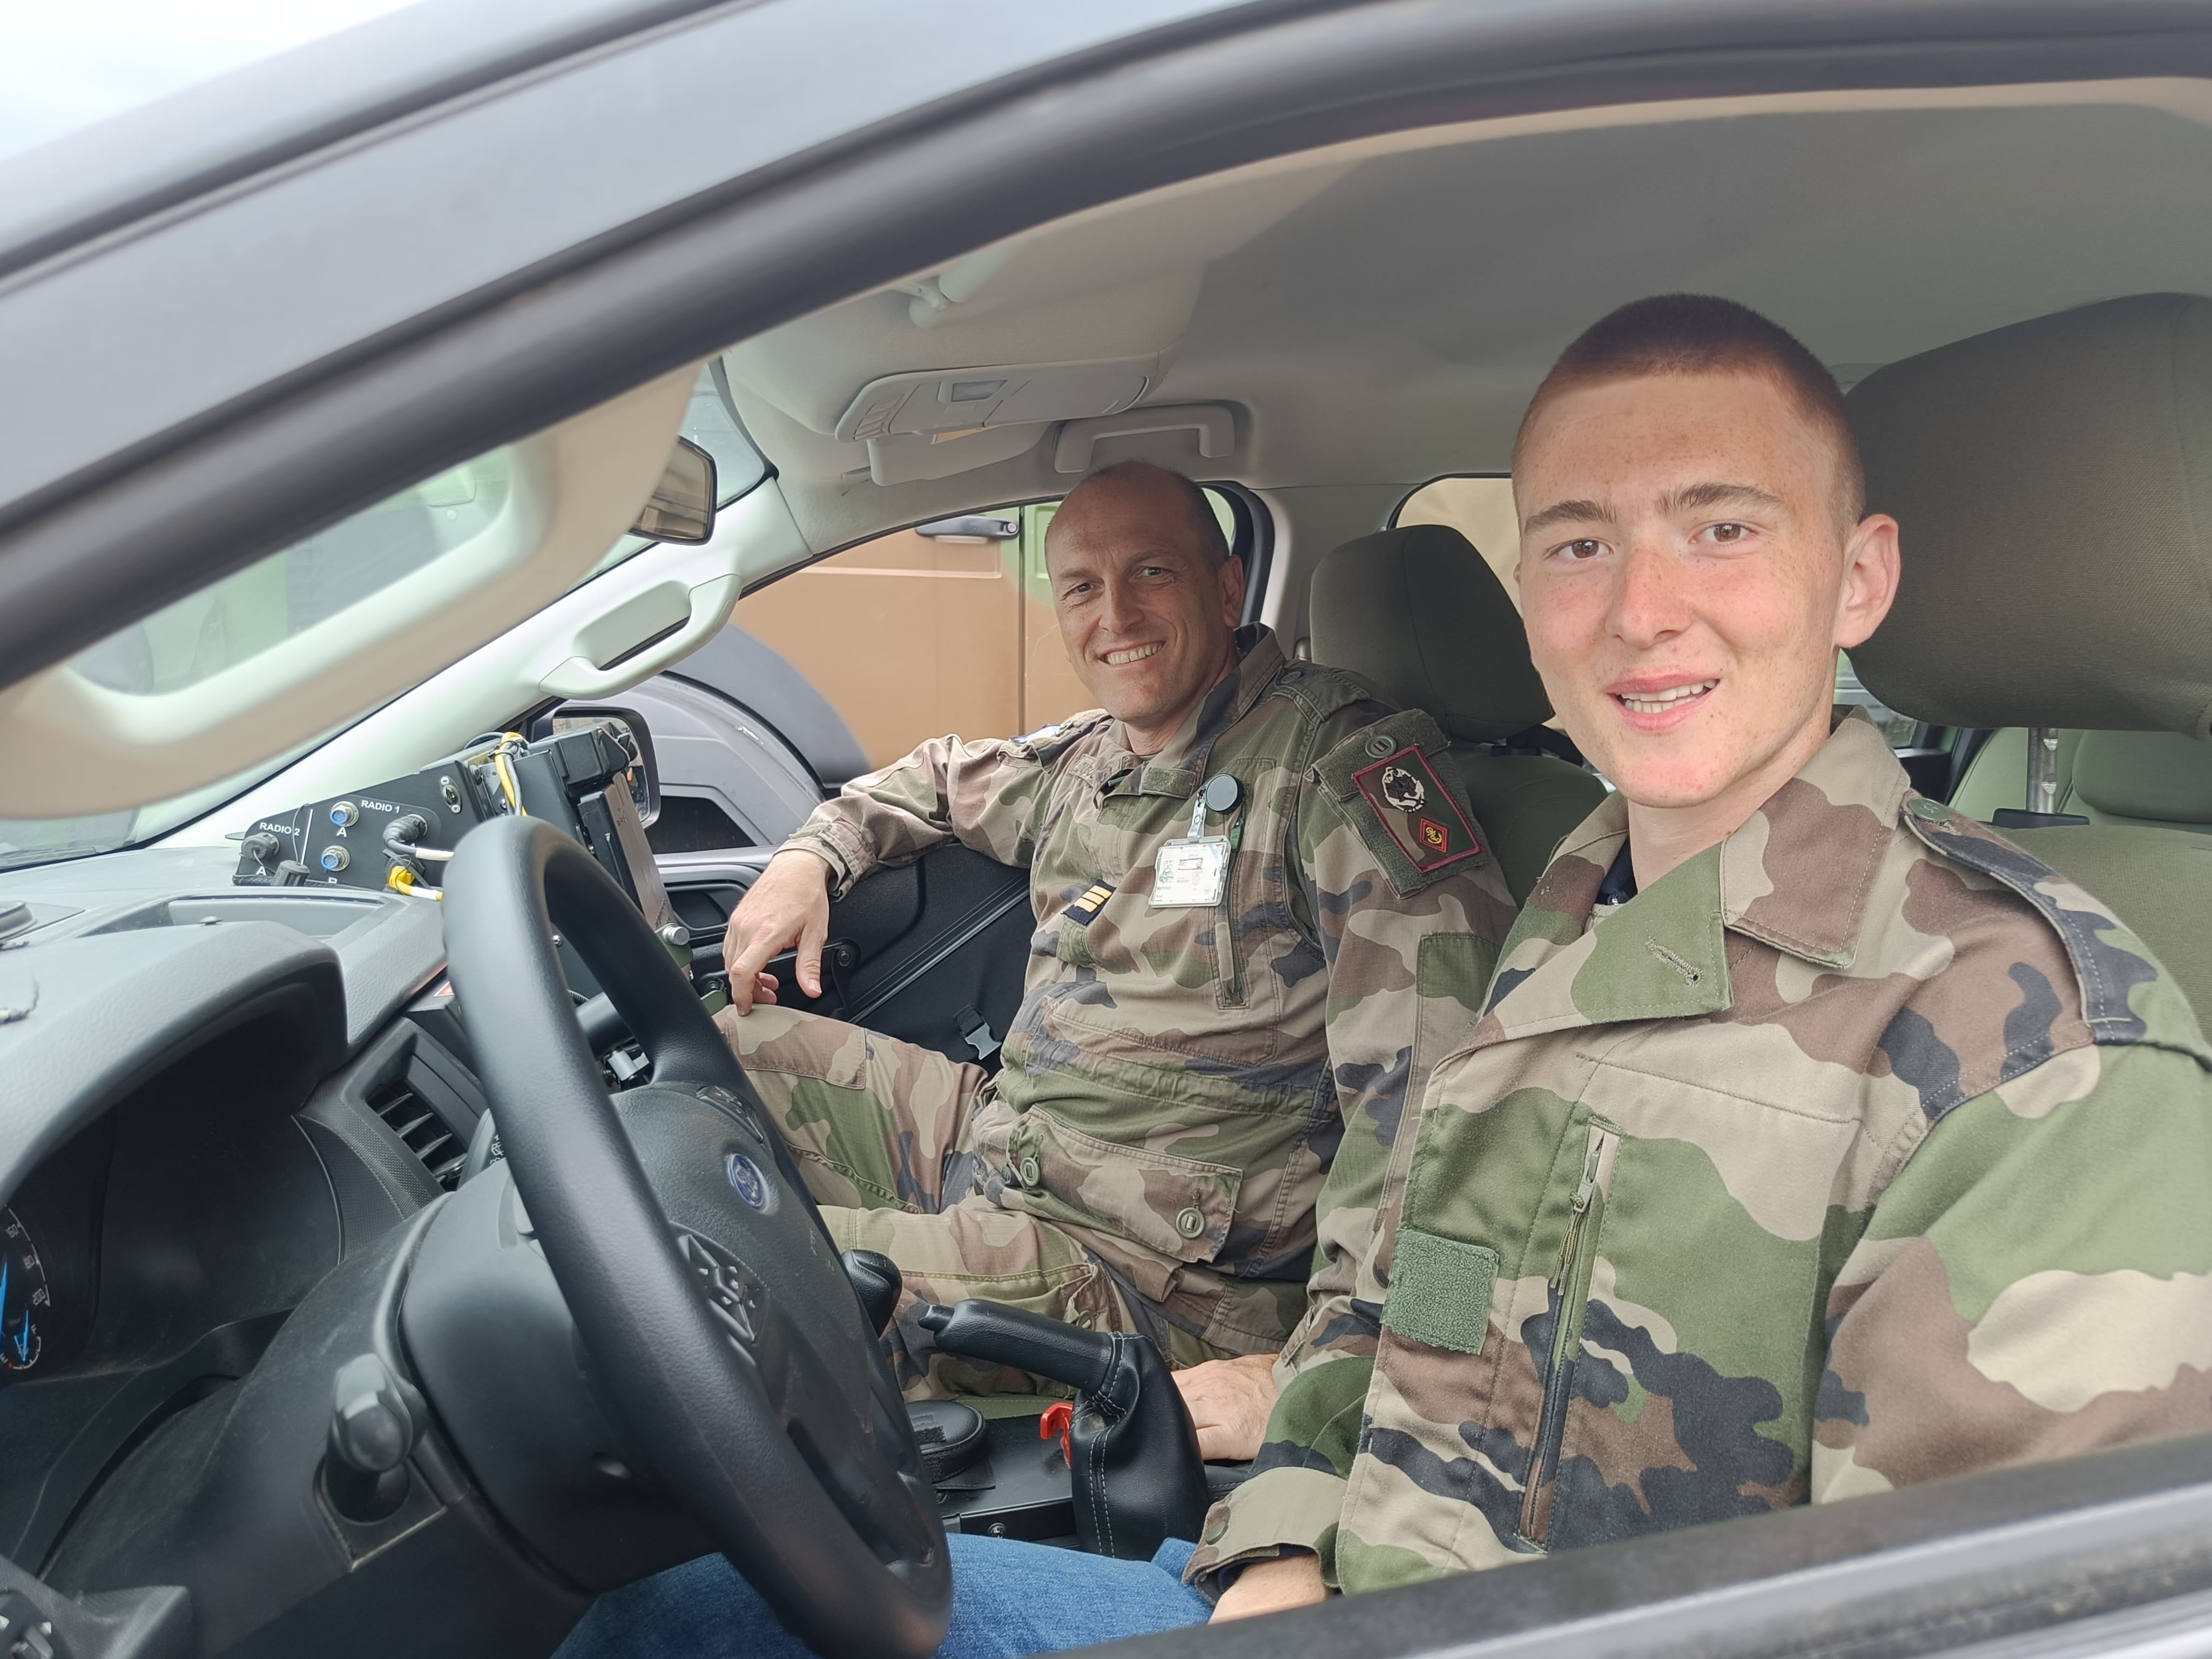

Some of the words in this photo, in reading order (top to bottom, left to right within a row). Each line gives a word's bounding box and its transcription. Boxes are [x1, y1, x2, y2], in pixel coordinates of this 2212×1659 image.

[361, 800, 393, 812] RADIO
[260, 822, 292, 834] RADIO
[294, 828, 300, 836] 2
[336, 827, 347, 837] A
[256, 866, 266, 875] A
